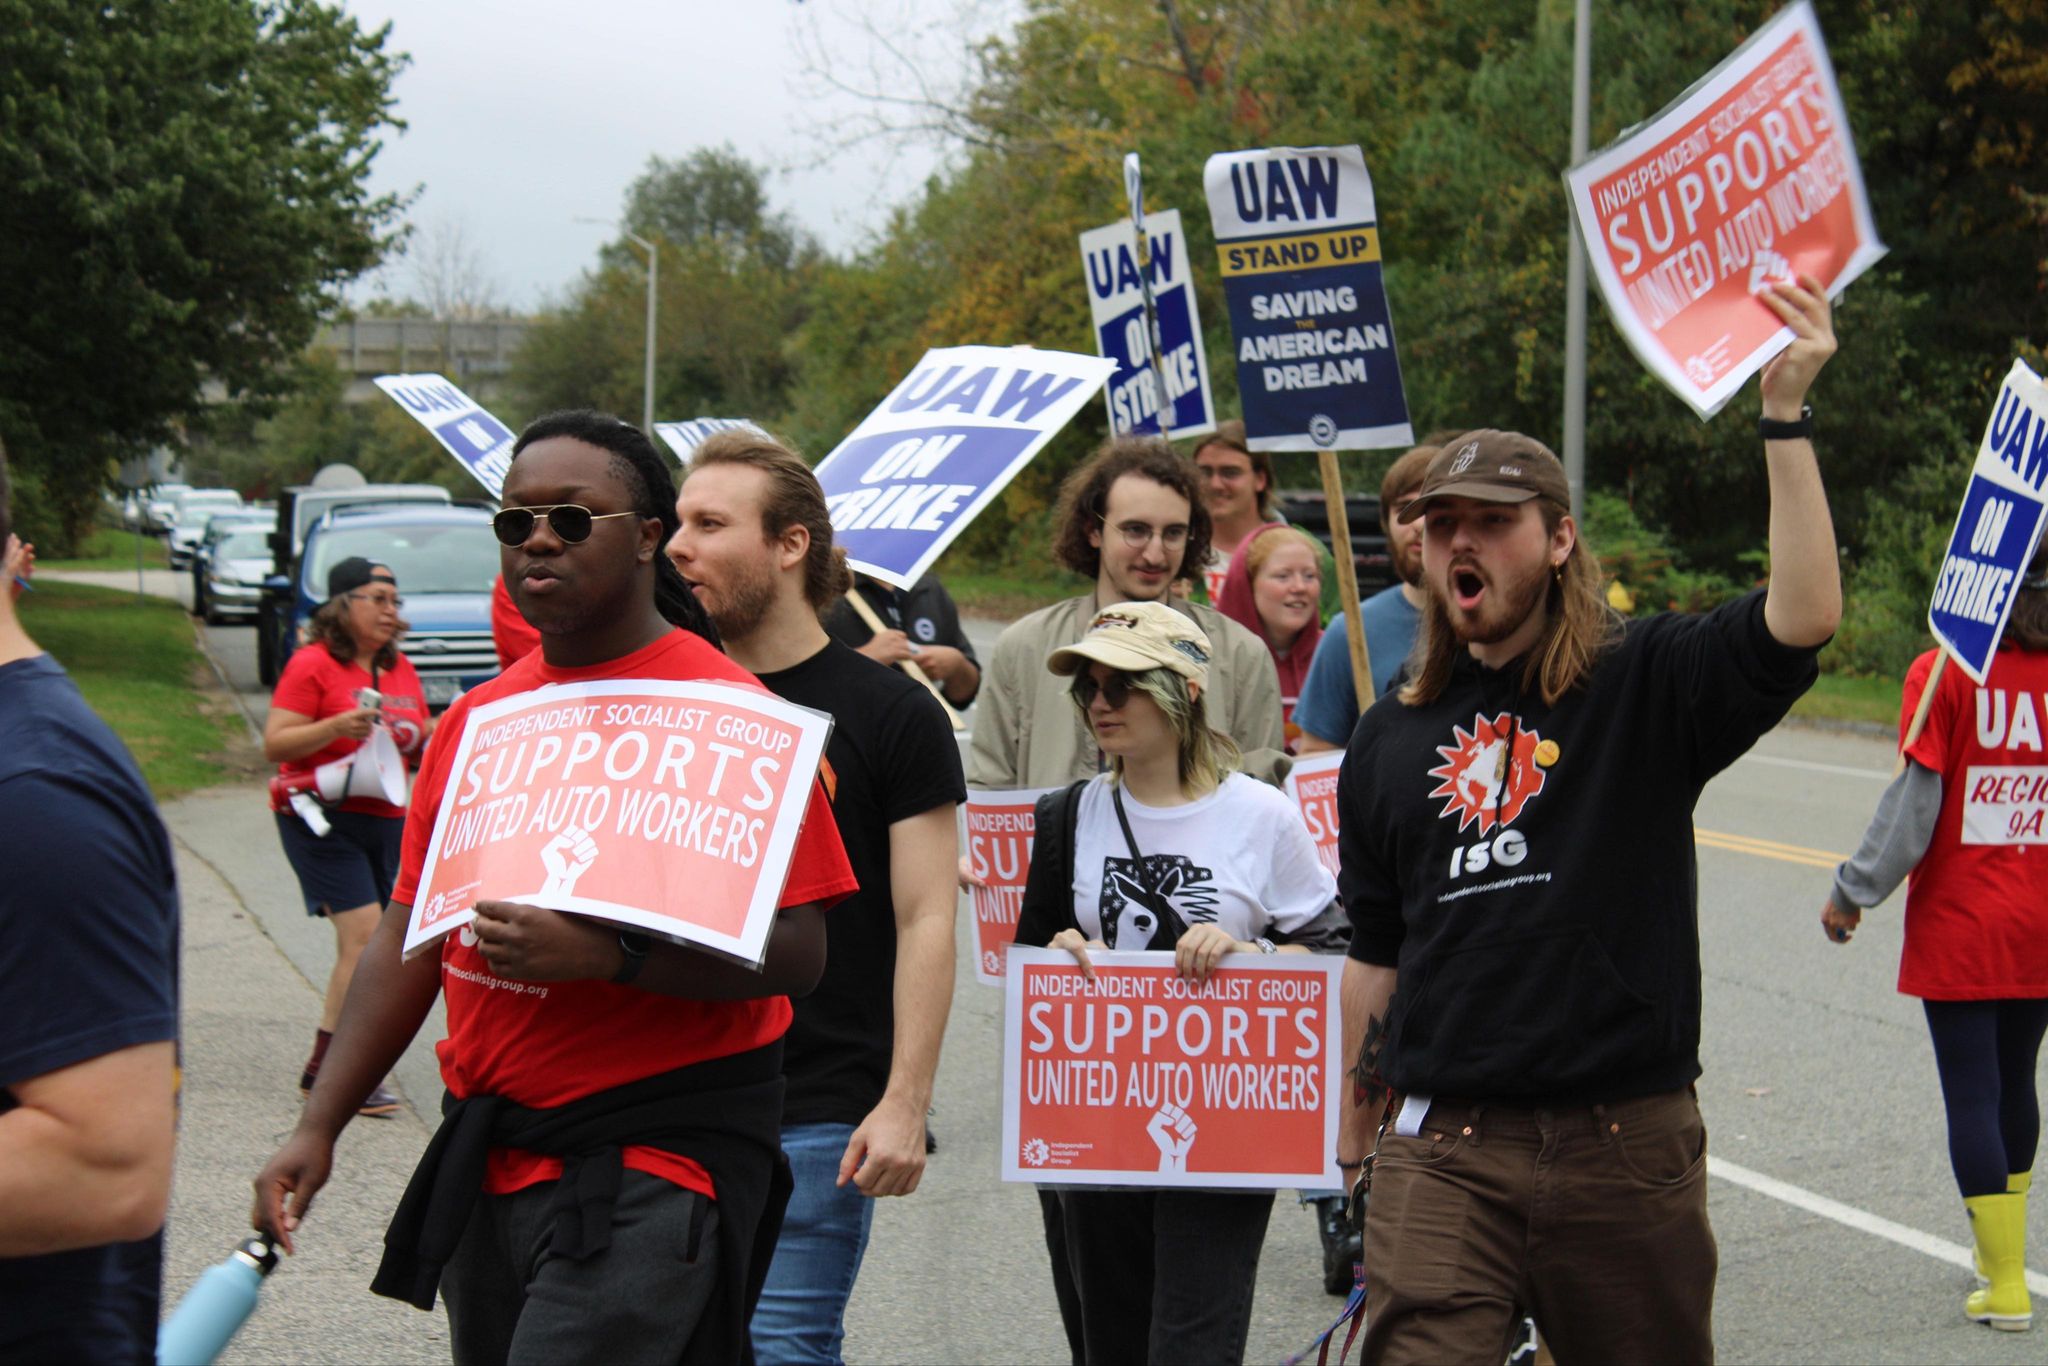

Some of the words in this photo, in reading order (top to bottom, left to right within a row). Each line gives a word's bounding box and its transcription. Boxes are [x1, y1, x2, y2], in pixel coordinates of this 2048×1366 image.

[1231, 156, 1339, 223] UAW
[1598, 124, 1711, 217] INDEPENDENT
[1609, 73, 1833, 275] SUPPORTS
[1228, 241, 1320, 270] STAND
[1329, 235, 1368, 259] UP
[1628, 240, 1715, 331] UNITED
[1715, 198, 1774, 280] AUTO
[1251, 286, 1358, 320] SAVING
[1240, 323, 1389, 362] AMERICAN
[393, 385, 470, 413] UAW
[889, 365, 1087, 423] UAW
[1113, 341, 1198, 434] STRKE
[1263, 357, 1368, 392] DREAM
[456, 418, 497, 451] ON
[860, 434, 967, 484] ON
[825, 484, 977, 531] TRIKE
[1970, 496, 2014, 558] ON
[1934, 554, 2014, 626] STRIKE
[476, 705, 601, 752] INDEPENDENT
[603, 704, 711, 731] SOCIALIST
[716, 715, 792, 753] GROUP
[1975, 687, 2048, 752] UA
[459, 731, 780, 811] SUPPORTS
[443, 792, 529, 860] UNITED
[526, 785, 611, 833] AUTO
[616, 787, 765, 868] WORKERS
[969, 812, 1036, 832] INDEPEND
[2006, 809, 2045, 839] 9A
[1450, 828, 1528, 879] ISG
[974, 885, 1026, 924] UNIT
[1029, 974, 1157, 999] INDEPENDENT
[1163, 976, 1252, 1001] SOCIALIST
[1258, 979, 1322, 1002] GROUP
[1029, 1001, 1320, 1059] SUPPORTS
[1027, 1059, 1118, 1107] UNITED
[1124, 1061, 1193, 1109] AUTO
[1201, 1062, 1320, 1111] WORKERS
